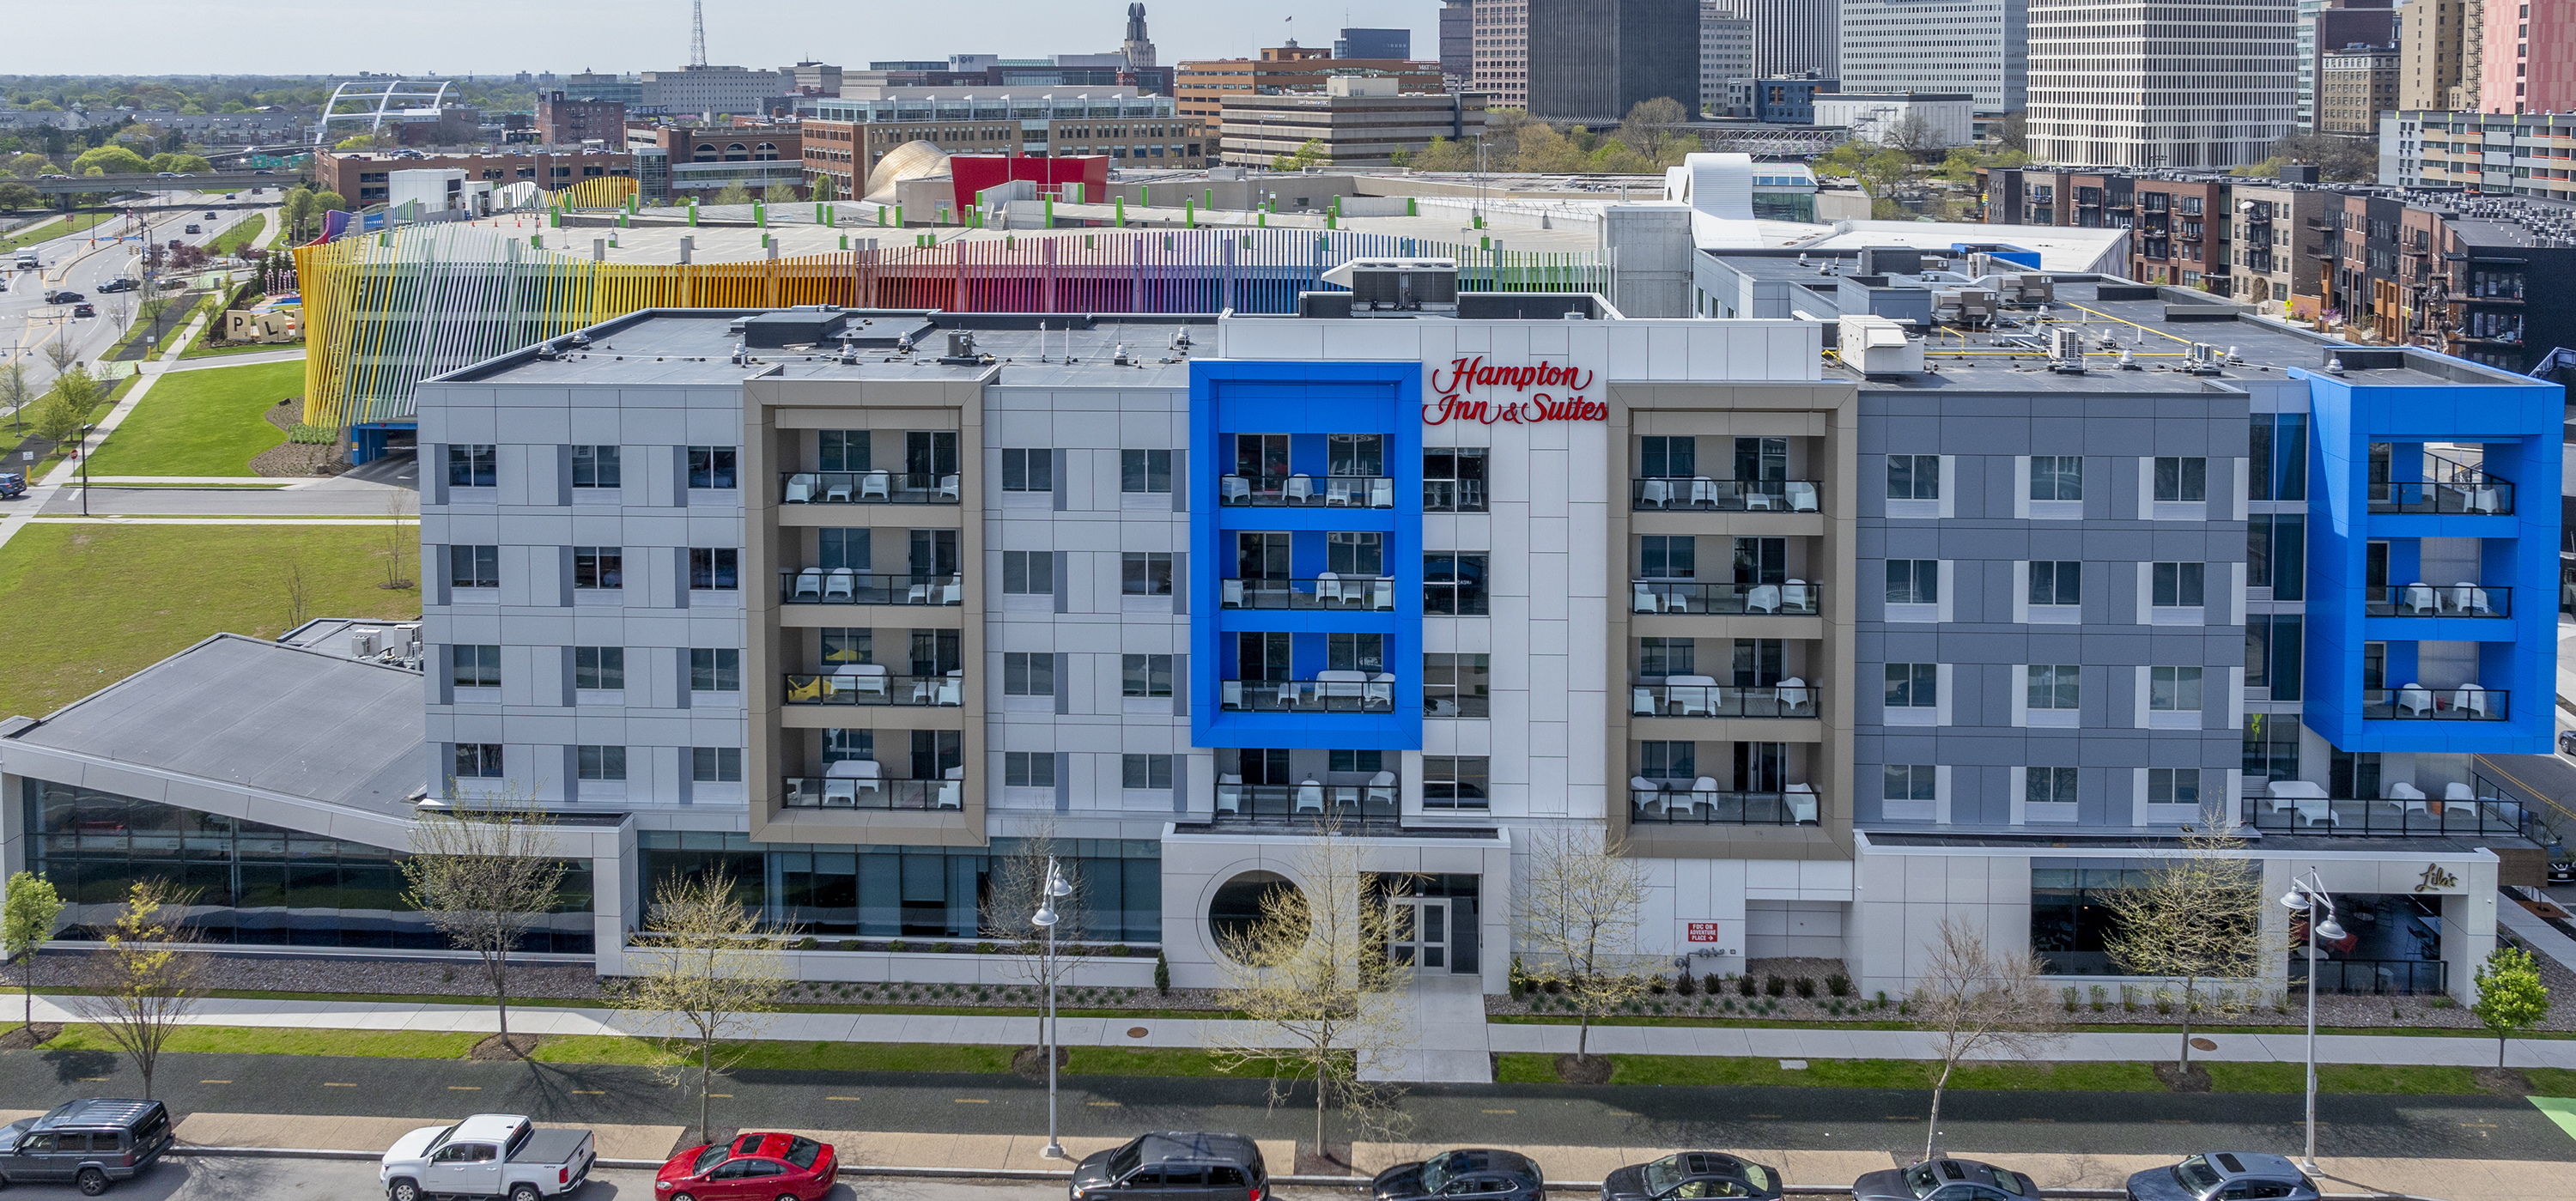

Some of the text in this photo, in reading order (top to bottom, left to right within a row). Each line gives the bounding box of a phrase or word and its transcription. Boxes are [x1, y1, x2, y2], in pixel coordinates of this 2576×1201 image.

[234, 317, 243, 331] P
[264, 320, 278, 336] L
[1432, 355, 1593, 394] Hampton
[1422, 392, 1608, 426] Inn & Suites
[2414, 862, 2459, 893] Lila's
